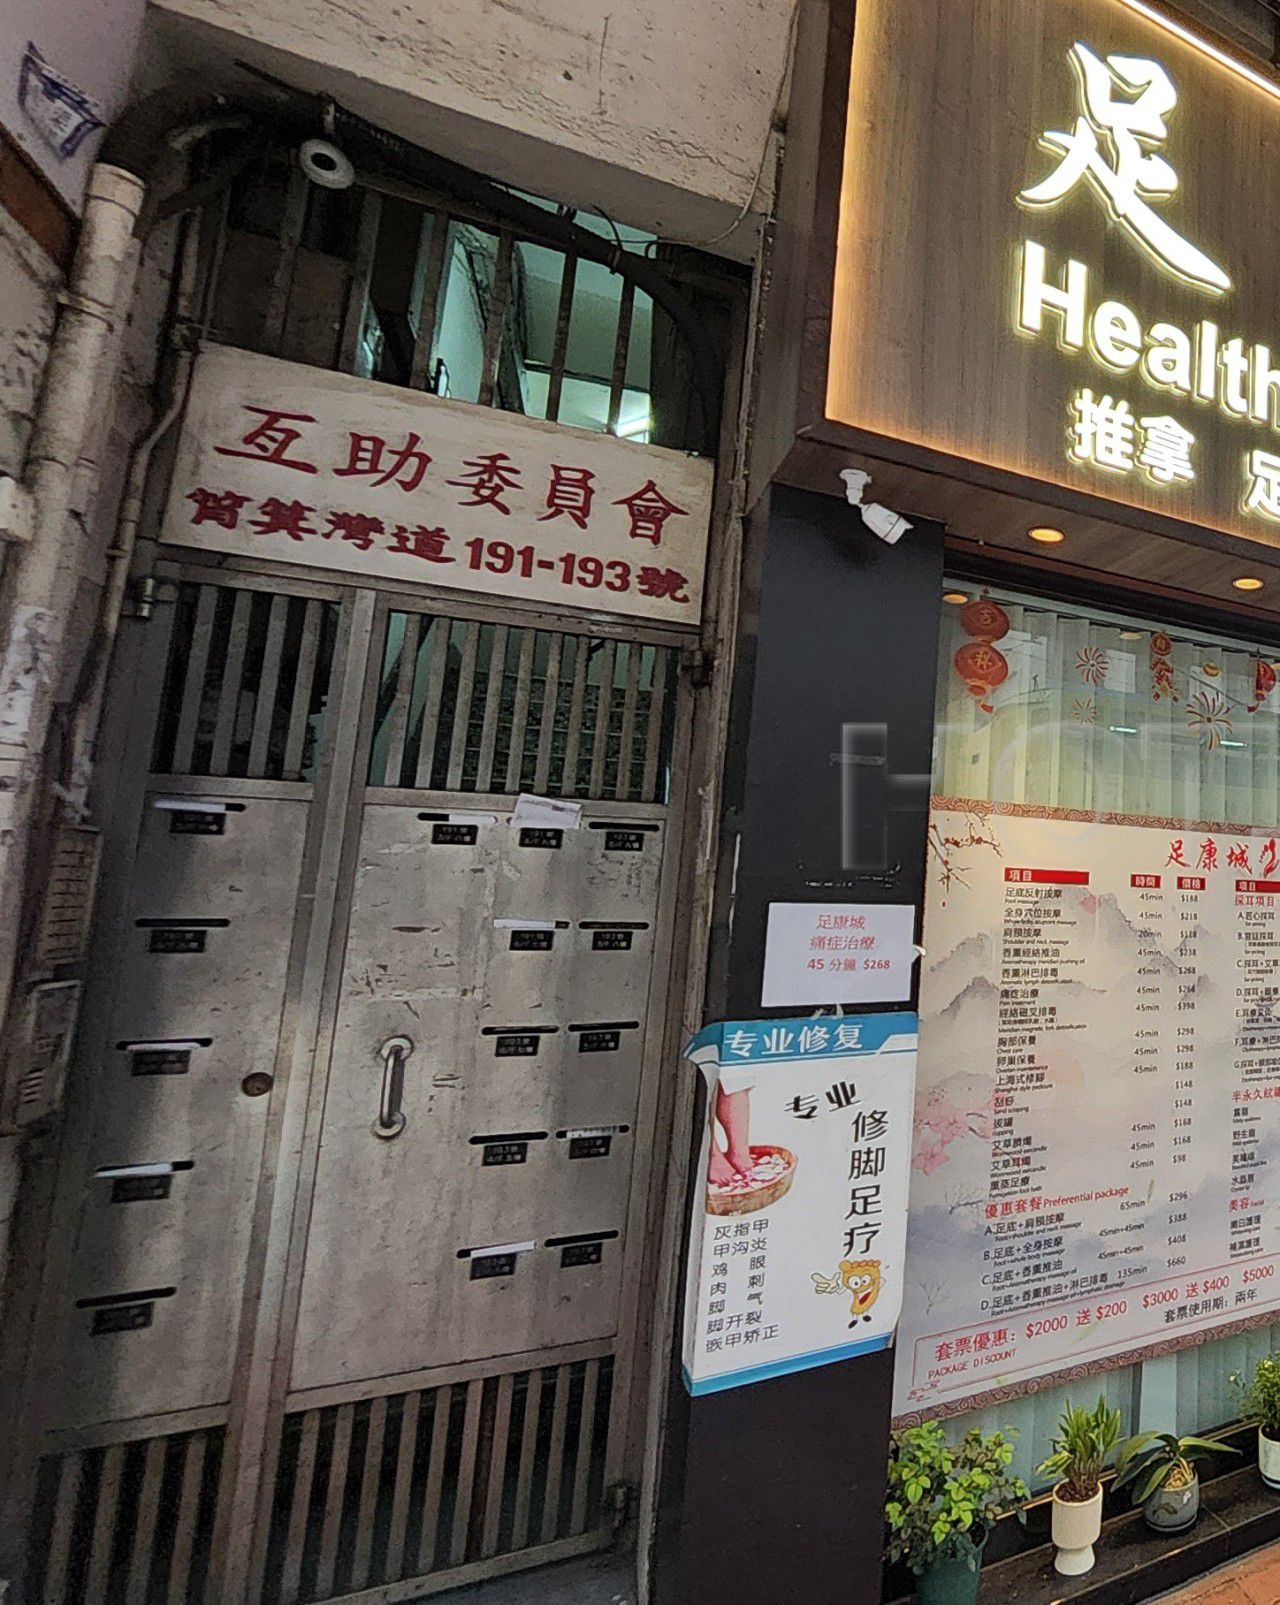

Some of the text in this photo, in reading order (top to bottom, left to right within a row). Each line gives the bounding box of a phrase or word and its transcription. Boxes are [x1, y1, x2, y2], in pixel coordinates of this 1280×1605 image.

[1067, 388, 1195, 487] 推拿
[214, 404, 691, 545] 互助委員會
[1164, 837, 1253, 874] 足康城
[1009, 869, 1031, 881] 項目
[1140, 893, 1163, 901] 45min
[816, 914, 865, 930] 足康城
[807, 958, 824, 970] 45
[863, 958, 890, 970] $268
[1136, 968, 1160, 976] 45min
[1136, 1004, 1159, 1012] 45min
[1135, 1030, 1159, 1038] 45min
[724, 1024, 863, 1057] 专业修复
[1134, 1048, 1158, 1056] 45min
[1134, 1065, 1157, 1074] 45min
[1175, 1080, 1193, 1089] $148
[784, 1081, 861, 1119] 专业
[1175, 1099, 1192, 1109] $148
[1131, 1122, 1155, 1132] 45min
[1131, 1141, 1154, 1151] 45min
[1130, 1159, 1154, 1169] 45min
[843, 1110, 889, 1257] 修脚足疗
[1044, 1191, 1093, 1208] Preferential
[1095, 1188, 1129, 1201] package
[714, 1218, 769, 1240] 灰指甲
[713, 1237, 767, 1257] 甲沟炎
[1025, 1315, 1068, 1339] $2000
[1076, 1307, 1091, 1327] 送
[1096, 1300, 1127, 1321] $200
[1142, 1288, 1178, 1309] $3000
[1202, 1276, 1230, 1295] $400
[1242, 1264, 1275, 1284] $5000
